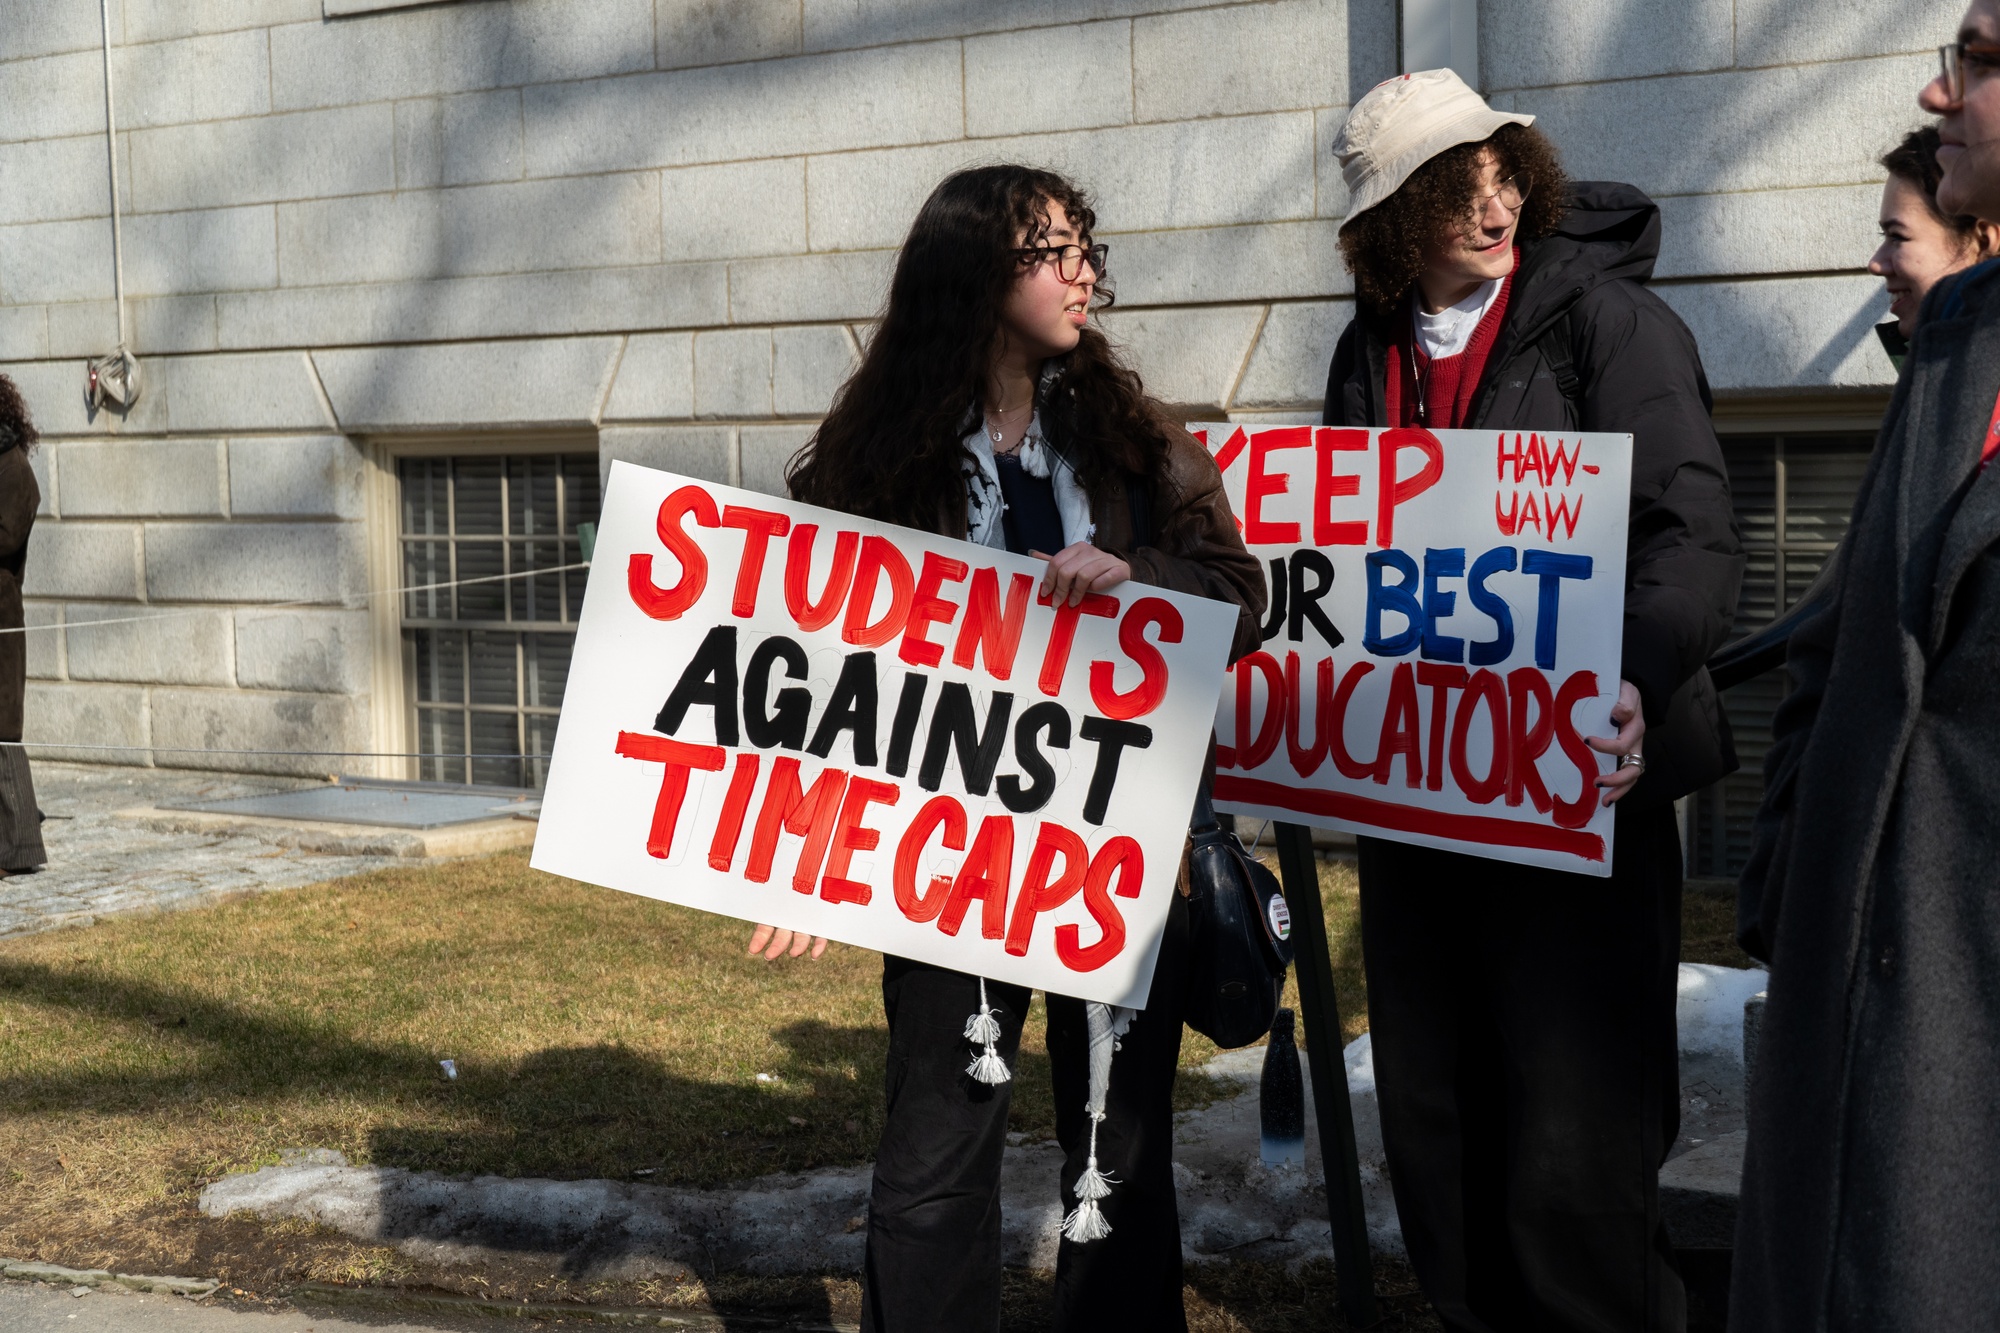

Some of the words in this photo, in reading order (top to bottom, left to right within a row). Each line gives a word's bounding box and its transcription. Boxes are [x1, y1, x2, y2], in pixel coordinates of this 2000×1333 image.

[1495, 490, 1583, 543] UAW
[1496, 432, 1601, 487] HAW-
[627, 485, 1184, 721] STUDENTS
[1261, 549, 1345, 649] UR
[1362, 546, 1594, 671] BEST
[653, 624, 1153, 826] AGAINST
[614, 729, 901, 906] TIME
[892, 795, 1145, 973] CAPS
